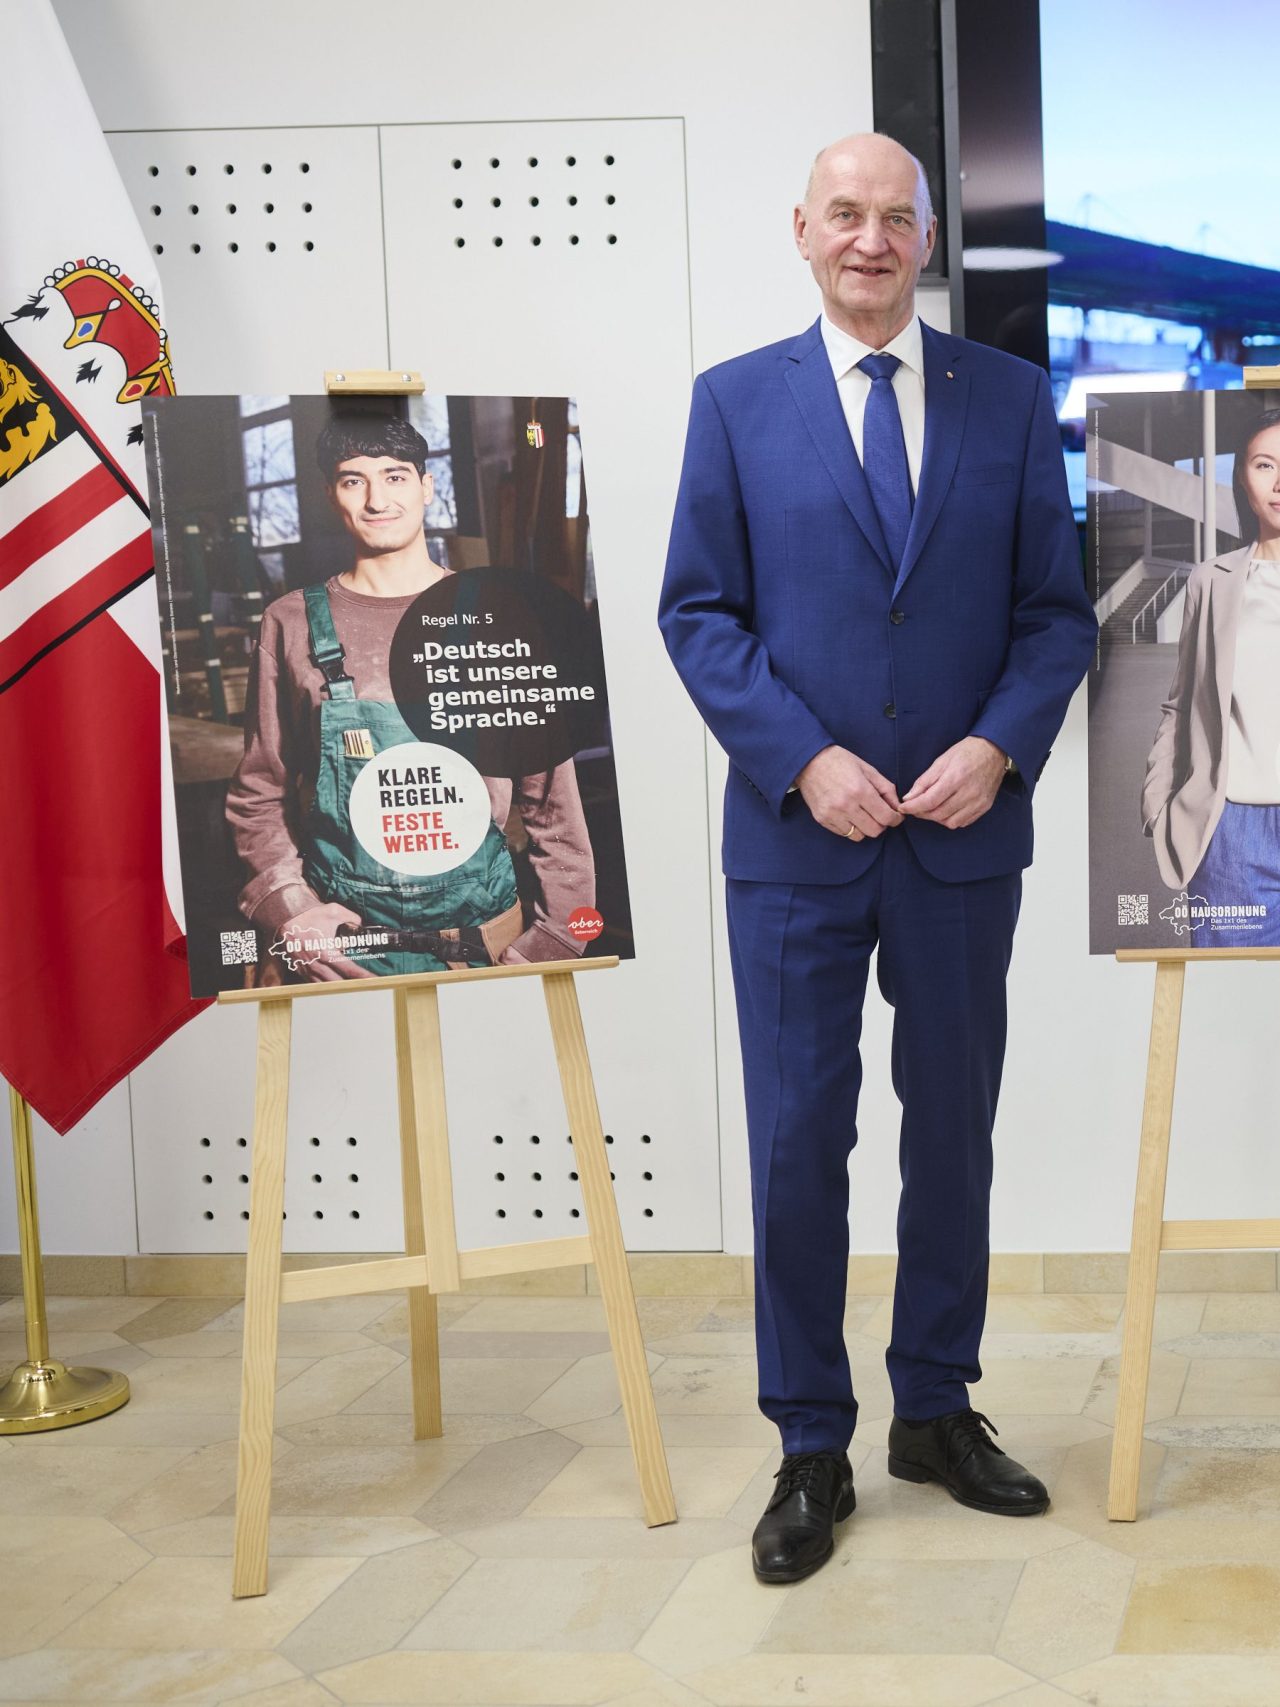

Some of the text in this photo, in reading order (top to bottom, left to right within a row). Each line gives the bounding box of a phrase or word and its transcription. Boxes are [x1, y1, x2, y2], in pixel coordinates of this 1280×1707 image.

[422, 613, 493, 628] Regel Nr. 5
[413, 638, 531, 663] „Deutsch
[426, 664, 557, 684] ist unsere
[428, 685, 595, 711] gemeinsame
[430, 704, 556, 733] Sprache.“
[378, 766, 442, 787] KLARE
[380, 786, 464, 808] REGELN.
[382, 812, 444, 833] FESTE
[383, 832, 459, 854] WERTE.
[1174, 905, 1267, 918] OÖ HAUSORDNUNG
[286, 932, 389, 953] OÖ HAUSORDNUNG
